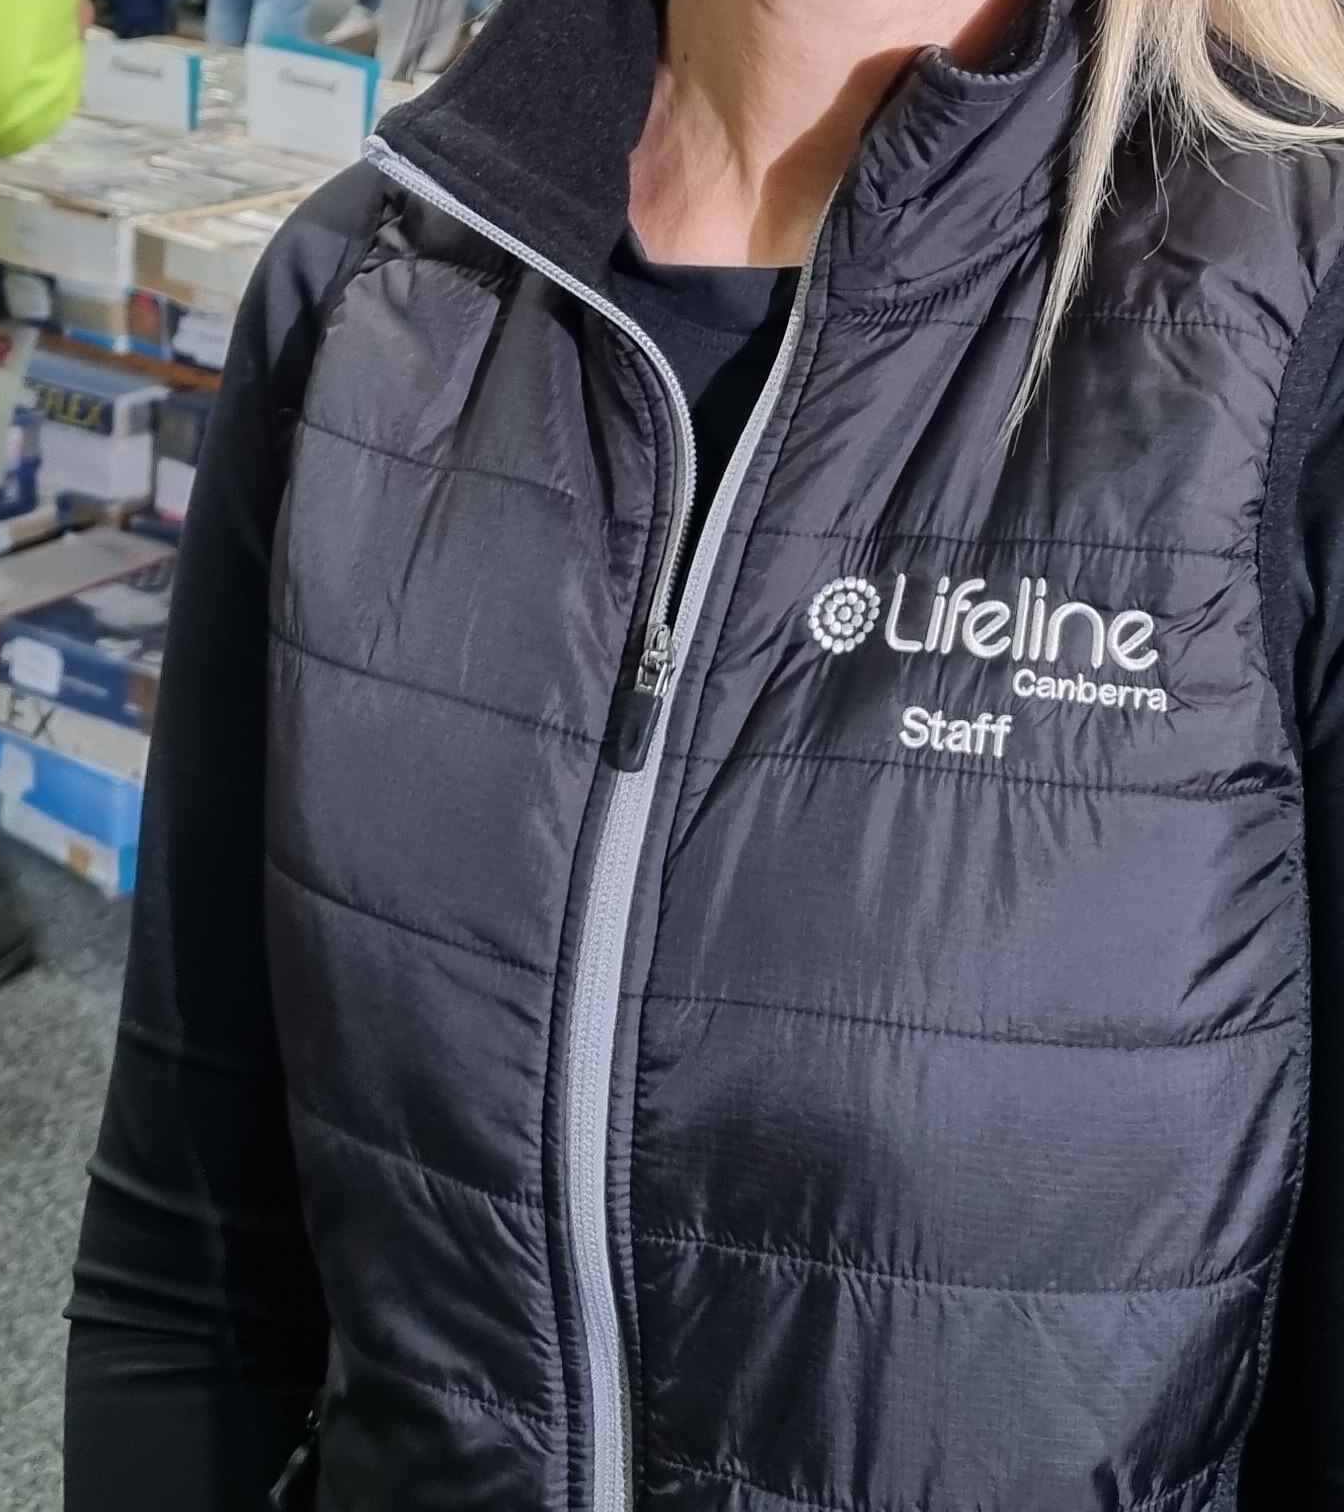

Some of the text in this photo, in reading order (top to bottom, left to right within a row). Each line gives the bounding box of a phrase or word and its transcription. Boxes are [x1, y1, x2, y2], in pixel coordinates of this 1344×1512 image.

[885, 572, 1159, 672] Lifeline
[1012, 667, 1168, 713] Canberra
[899, 705, 1013, 759] Staff
